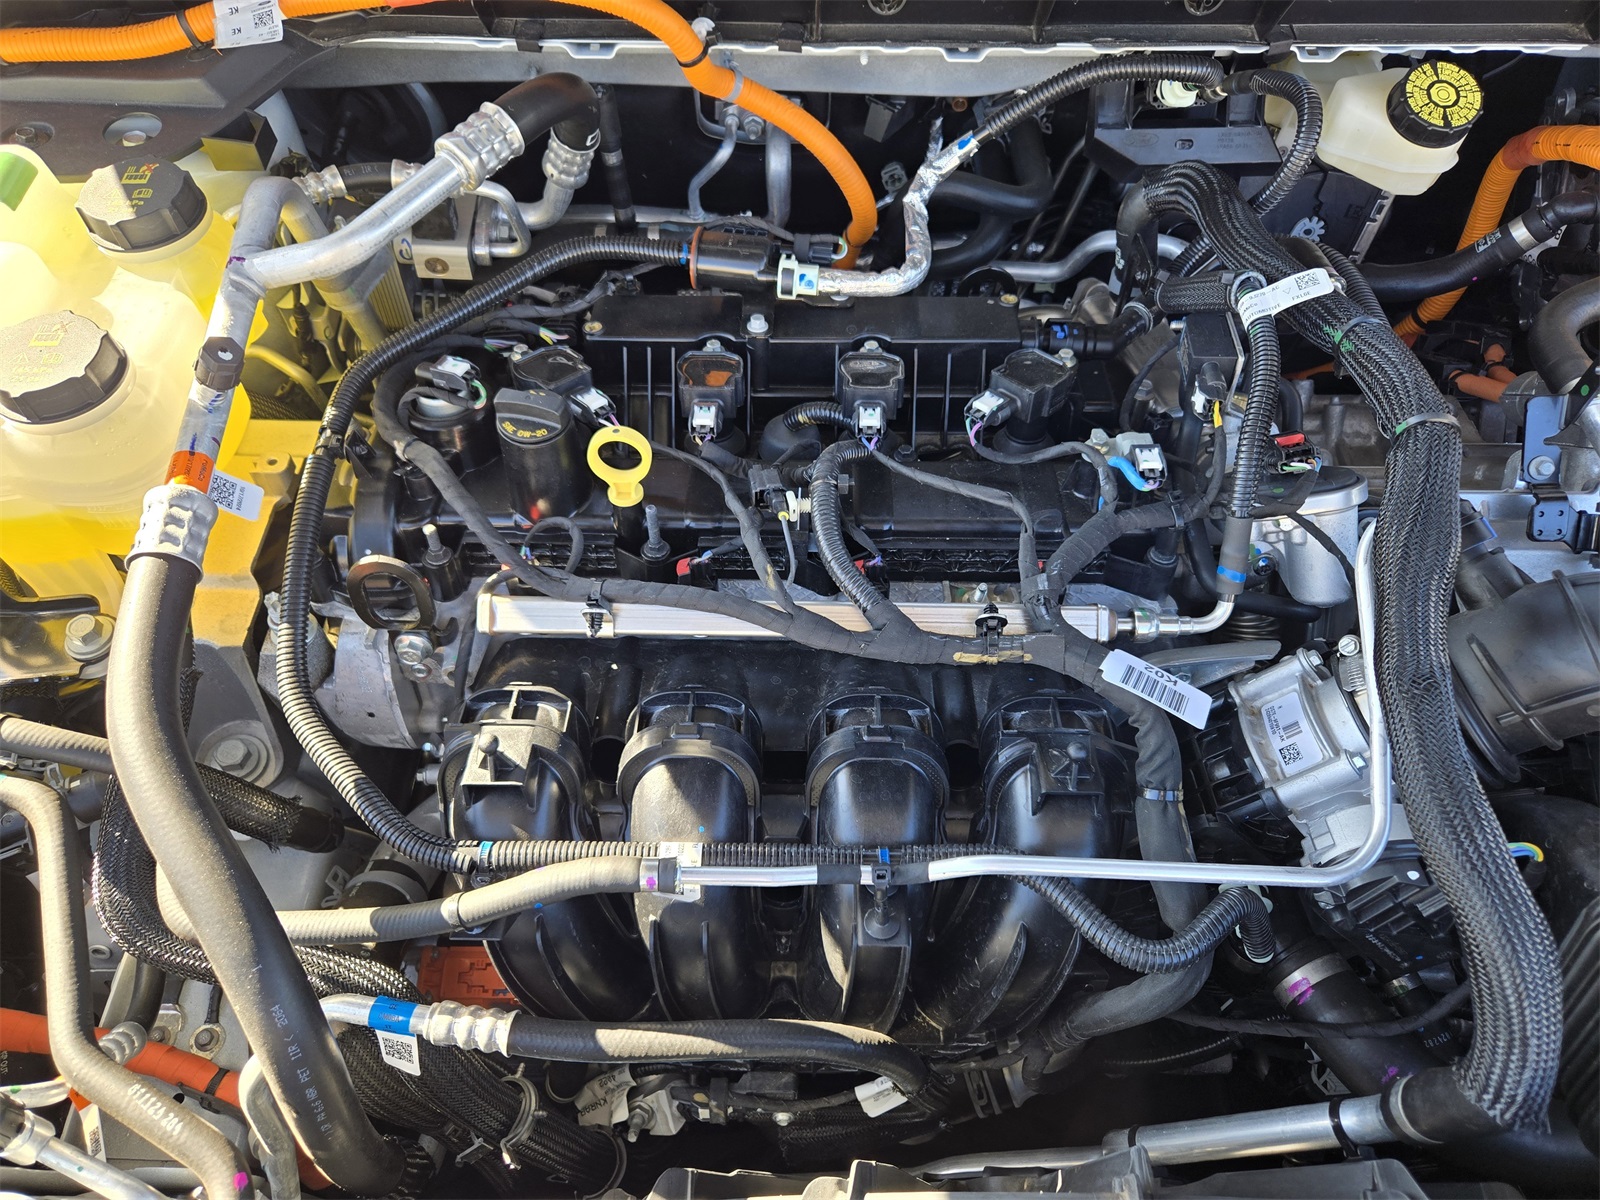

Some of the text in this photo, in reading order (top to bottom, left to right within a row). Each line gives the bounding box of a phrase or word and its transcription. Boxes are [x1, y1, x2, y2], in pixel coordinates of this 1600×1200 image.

[228, 6, 239, 16] KE
[231, 26, 242, 36] KE
[1244, 303, 1282, 323] AUTOMOTIVE
[501, 421, 548, 438] SAE 0W-20
[1144, 662, 1178, 687] K02
